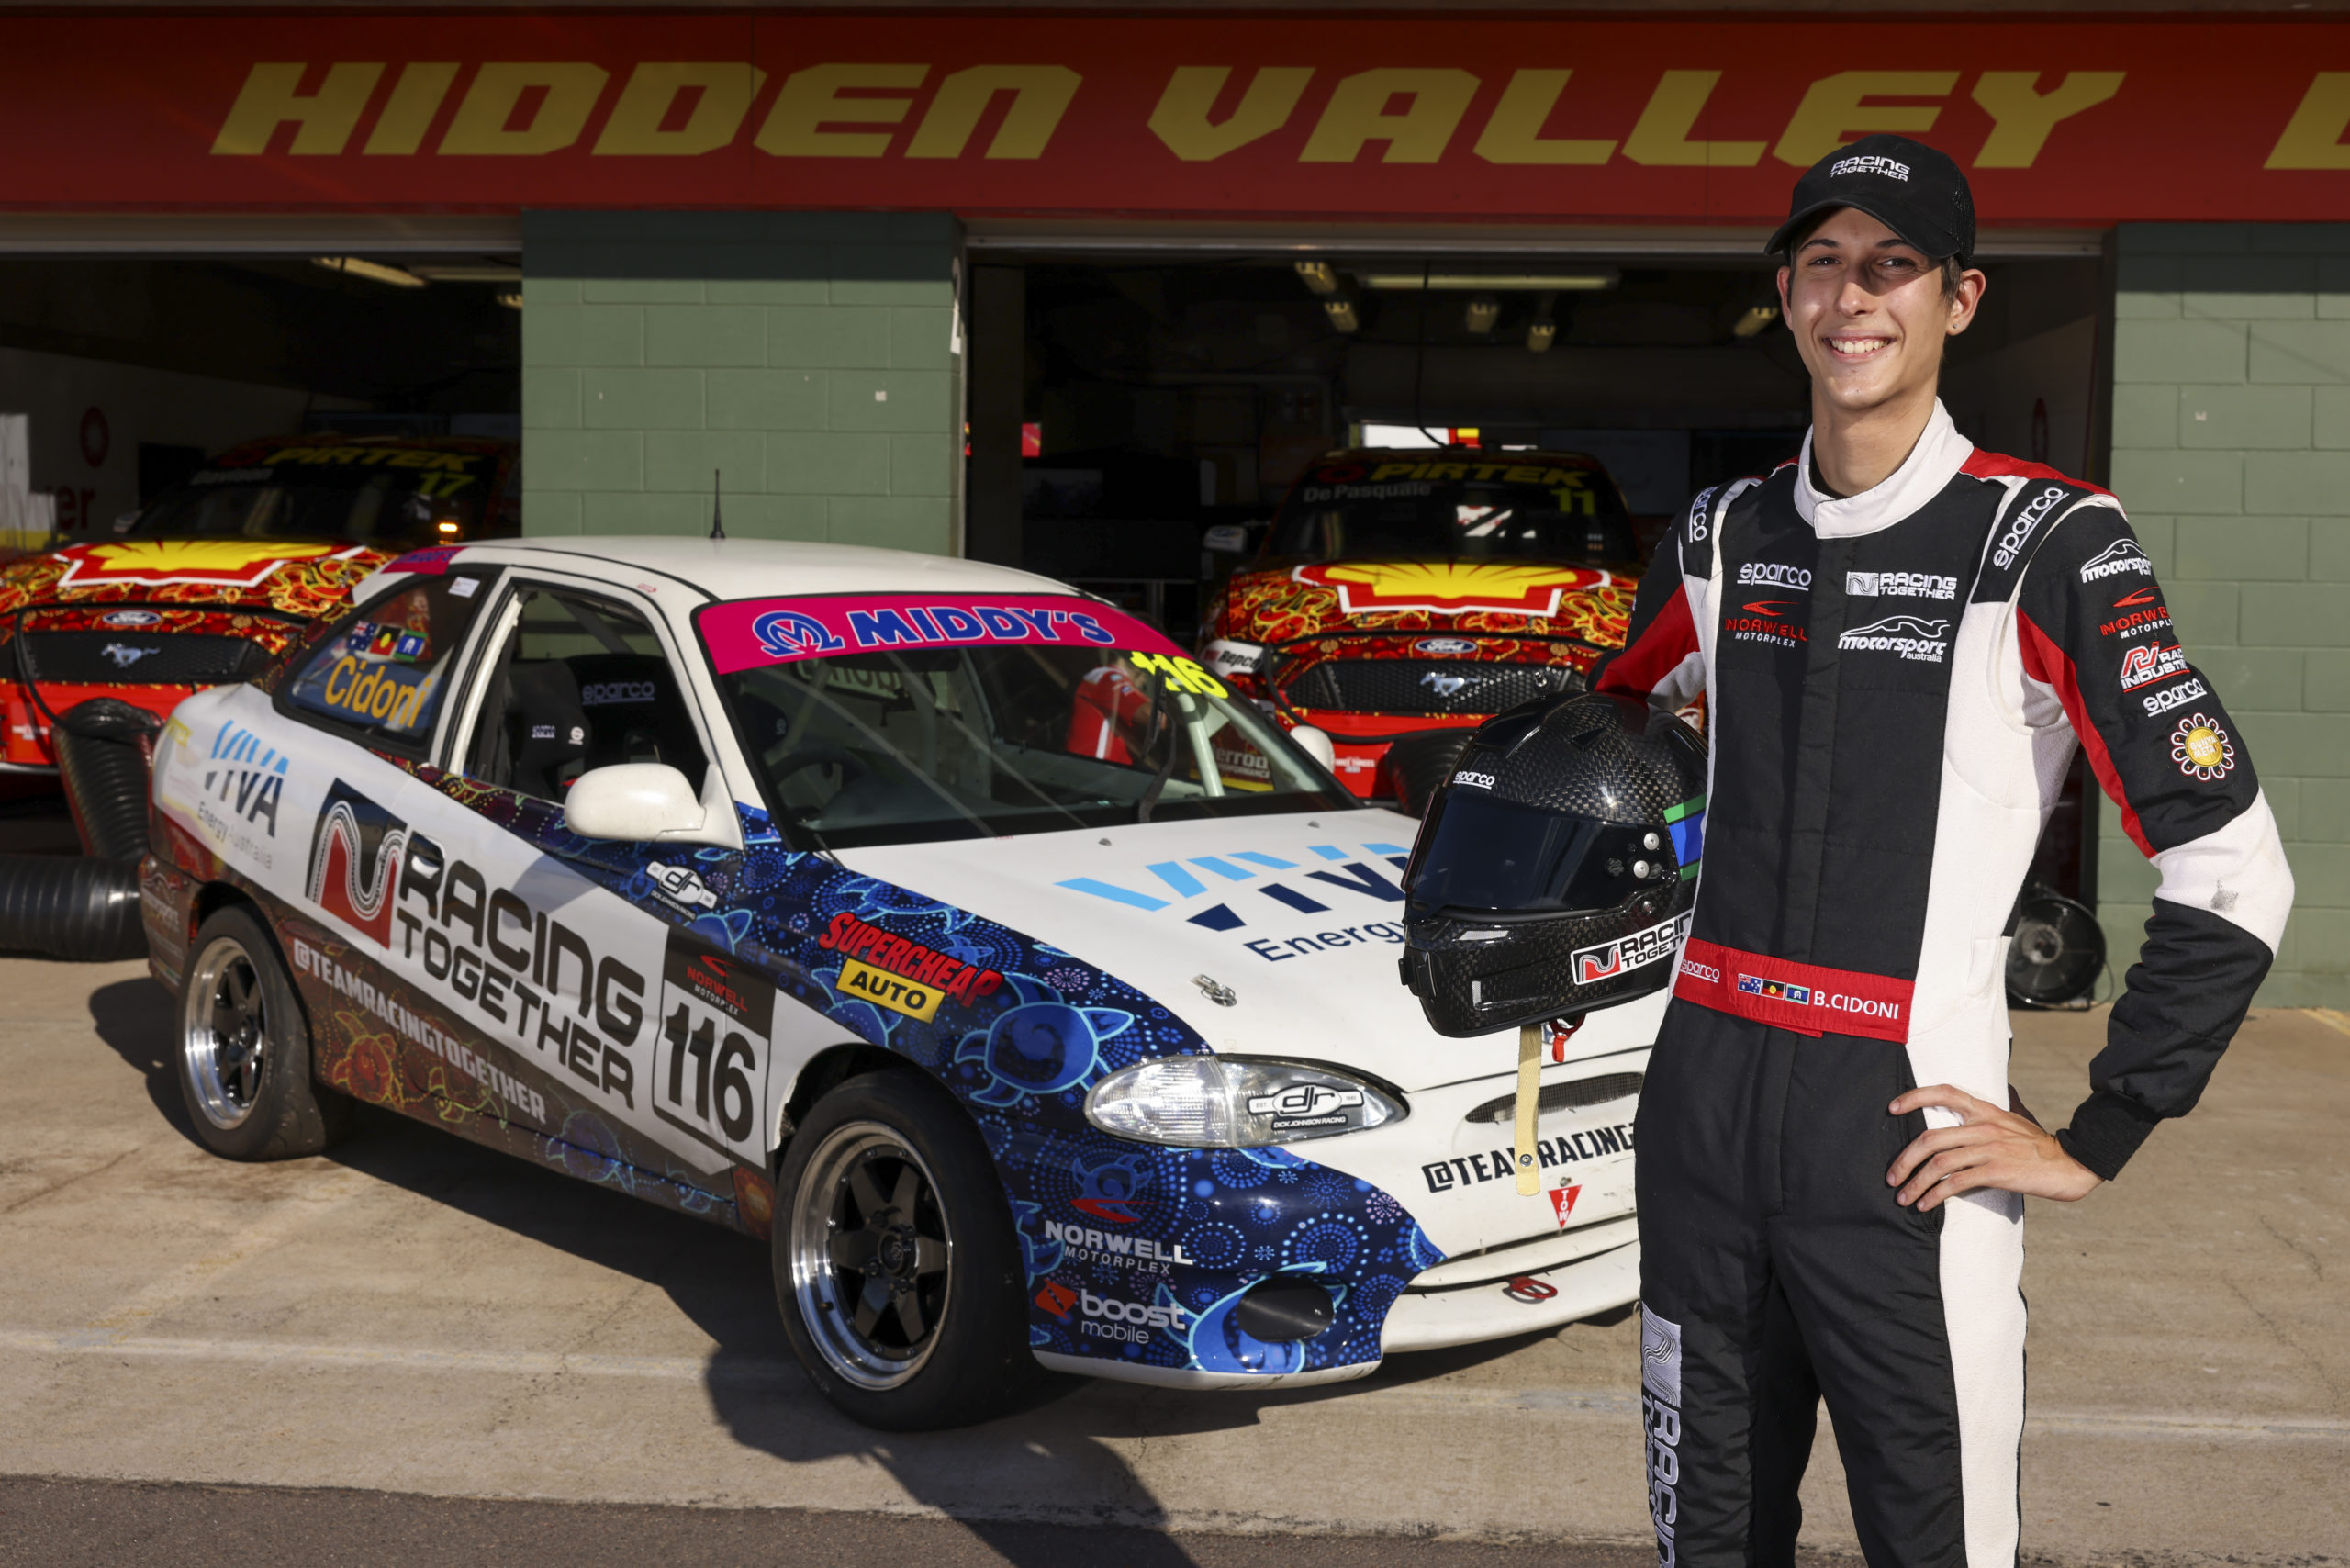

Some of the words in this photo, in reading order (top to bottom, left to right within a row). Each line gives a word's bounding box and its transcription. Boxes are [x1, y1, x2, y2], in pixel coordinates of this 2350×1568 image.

[210, 61, 1084, 160] HIDDEN
[1147, 65, 2128, 169] VALLEY
[1829, 165, 1908, 182] TOGETHER
[1830, 155, 1910, 174] RACING
[263, 446, 482, 473] PIRTEK
[418, 471, 480, 498] 17
[1370, 462, 1593, 488] PIRTEK
[1550, 487, 1596, 516] 11
[1992, 487, 2070, 571] sparco
[1737, 563, 1812, 591] sparco
[1880, 572, 1957, 590] RACING
[1879, 586, 1955, 600] TOGETHER
[846, 606, 1115, 646] MIDDY'S
[1725, 618, 1807, 642] NORWELL
[2099, 606, 2170, 636] NORWE
[2120, 618, 2174, 639] MOTORPL
[1735, 632, 1796, 648] MOTORPLEX
[1838, 635, 1947, 658] motorsport
[1906, 651, 1942, 663] australia
[2158, 648, 2184, 664] RAC
[324, 655, 432, 729] Cidoni
[582, 681, 655, 705] sparco
[2143, 678, 2208, 718] sparco
[204, 719, 290, 840] VIVA
[1453, 770, 1495, 790] sparco
[400, 831, 645, 1047] RACING
[1243, 921, 1406, 962] Energ
[819, 912, 1004, 1008] SUPERCHEAP
[1681, 958, 1721, 983] sparco
[687, 966, 749, 1013] NORWELL
[849, 969, 927, 1011] AUTO
[396, 909, 635, 1110] TOGETHER
[1813, 991, 1899, 1020] B.CIDONI
[291, 938, 547, 1126] @TEAMRACINGTOGETHER
[663, 1002, 755, 1143] 116
[1273, 1121, 1290, 1129] DICK
[1289, 1118, 1322, 1127] JOHNSON
[1321, 1115, 1347, 1125] RACING
[1558, 1189, 1570, 1222] TOW
[1045, 1219, 1194, 1266] NORWELL
[1065, 1245, 1171, 1275] MOTORPLEX
[1080, 1288, 1186, 1330] boost
[1081, 1320, 1150, 1344] mobile
